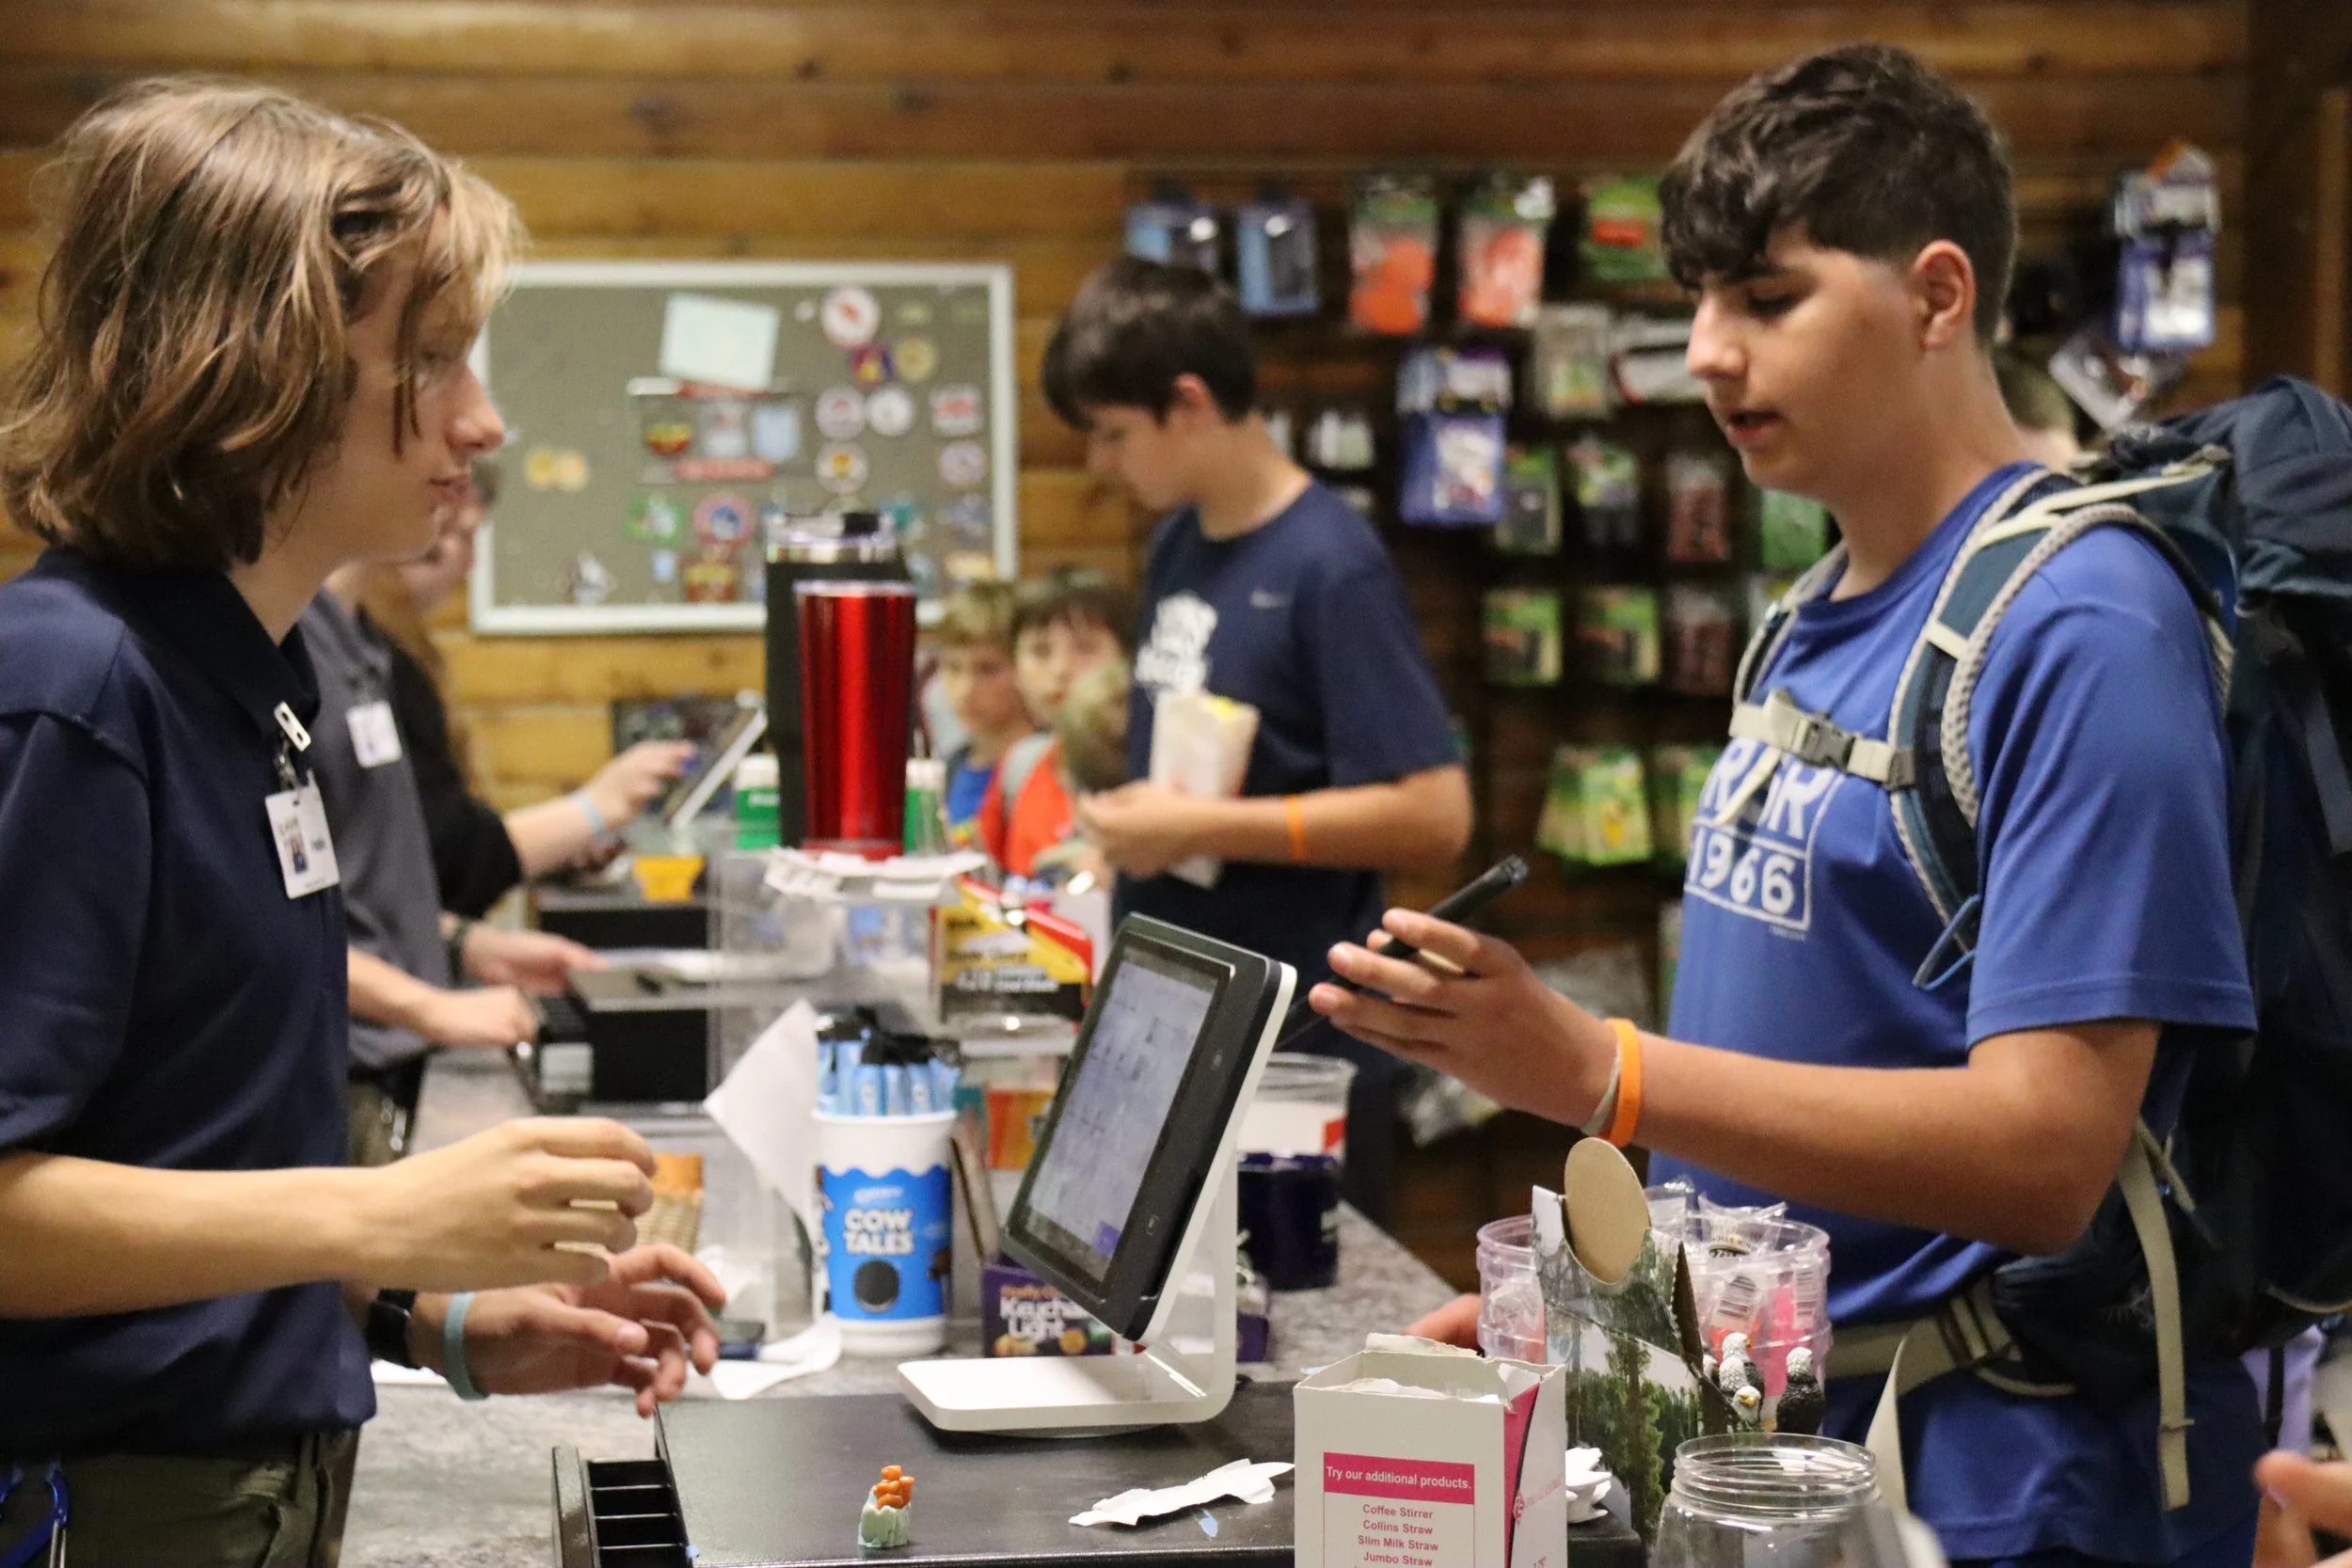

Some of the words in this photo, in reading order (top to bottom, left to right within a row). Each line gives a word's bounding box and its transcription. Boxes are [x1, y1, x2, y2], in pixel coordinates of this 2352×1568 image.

[1690, 827, 1795, 916] 1966
[844, 1208, 914, 1232] COW
[843, 1228, 915, 1256] TALES
[1008, 1316, 1066, 1343] Light
[1327, 1465, 1343, 1481] Try
[1345, 1469, 1363, 1481] our
[1366, 1471, 1417, 1485] additional
[1420, 1476, 1471, 1489] products.
[1362, 1504, 1397, 1516] Coffee
[1400, 1507, 1434, 1519] Stirrer
[1363, 1520, 1399, 1532] Collins
[1403, 1523, 1433, 1535] Straw
[1358, 1535, 1380, 1546] Slim
[1383, 1537, 1405, 1548] Milk
[1408, 1540, 1438, 1551] Straw
[1363, 1552, 1399, 1564] Jumbo
[1402, 1555, 1433, 1567] Straw
